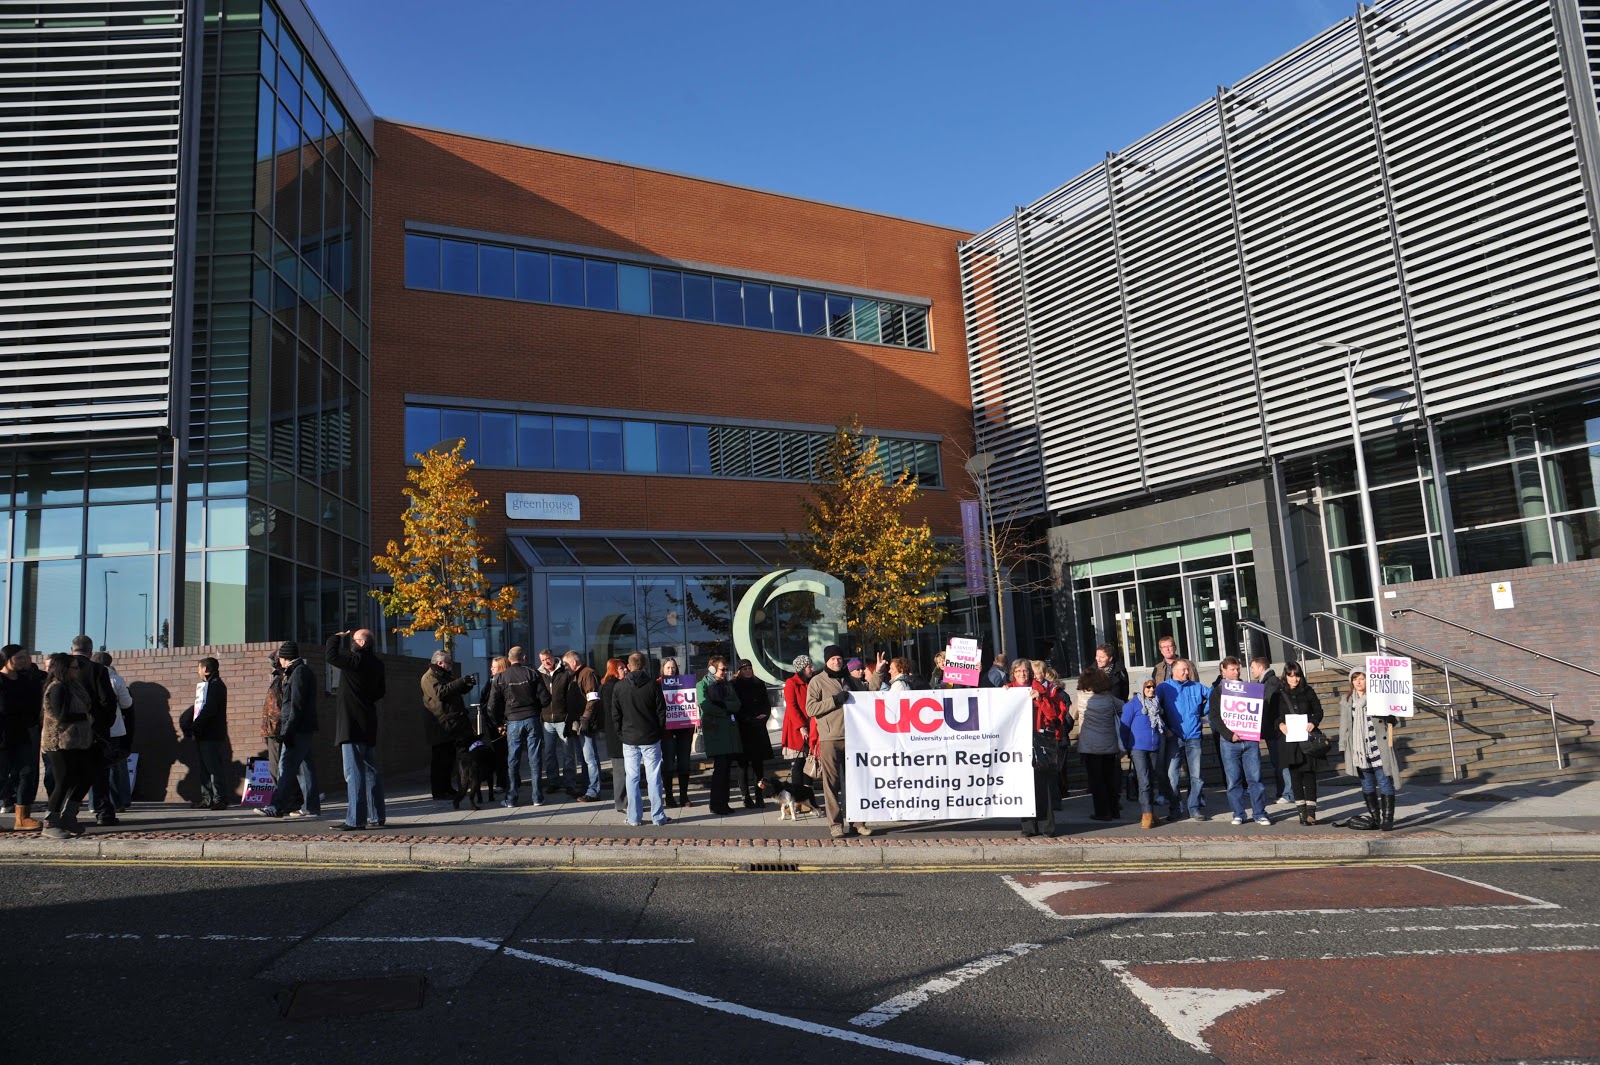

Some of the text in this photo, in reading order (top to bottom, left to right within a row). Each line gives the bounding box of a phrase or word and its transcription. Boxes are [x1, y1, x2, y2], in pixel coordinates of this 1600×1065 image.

[512, 498, 573, 511] greenhouse
[1369, 658, 1409, 667] HANDS
[1369, 666, 1390, 674] OFF
[1369, 680, 1410, 694] PENSIONS
[666, 704, 697, 712] OFFICIAL
[666, 710, 697, 719] DISPUTE
[1222, 711, 1259, 722] OFFICIAL
[910, 734, 942, 742] University
[956, 733, 981, 741] College
[981, 732, 1000, 740] Union
[855, 749, 1023, 768] Northern Region
[874, 774, 1004, 791] Defending Jobs
[860, 793, 1023, 811] Defending Education
